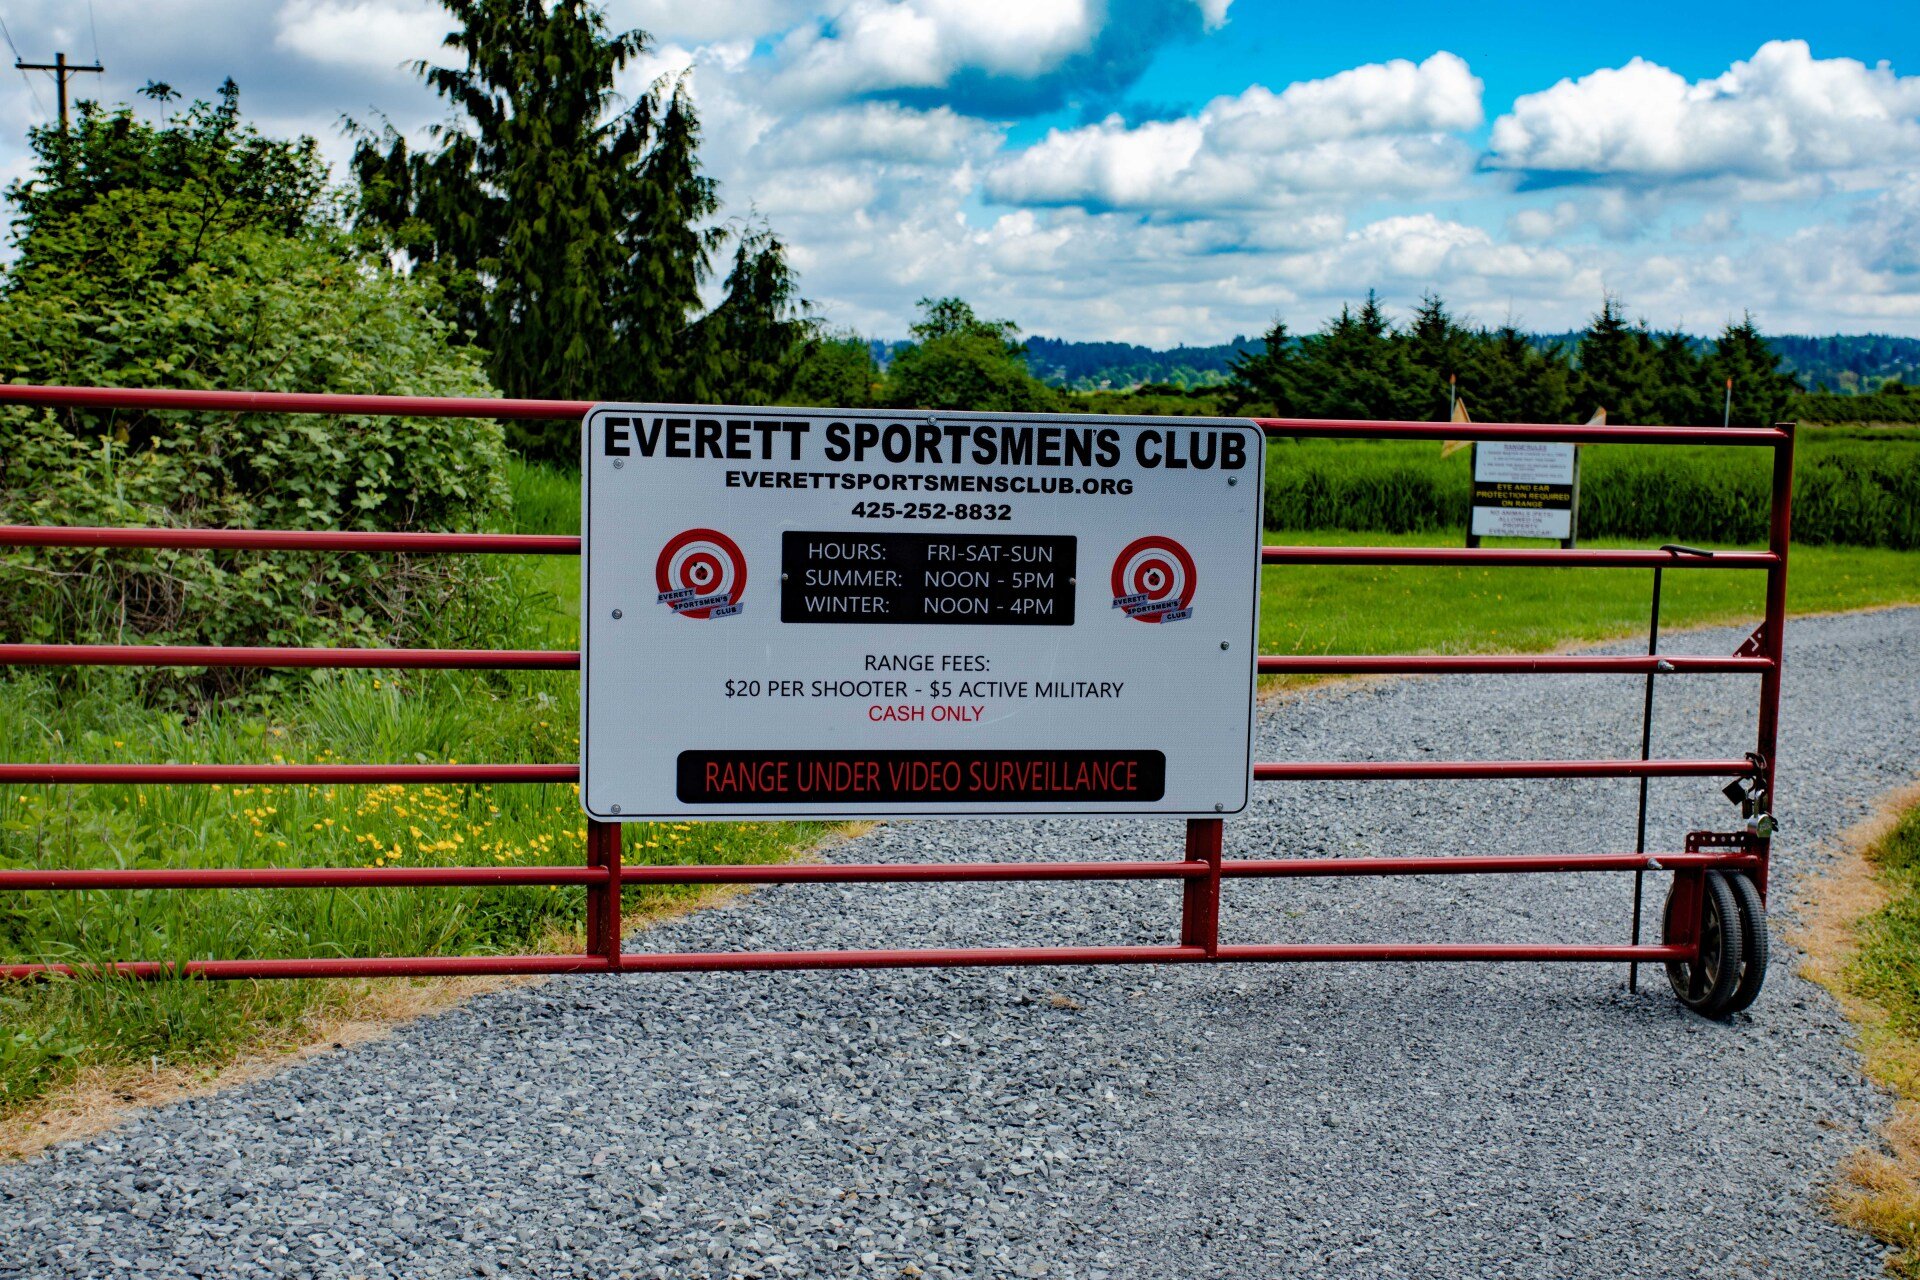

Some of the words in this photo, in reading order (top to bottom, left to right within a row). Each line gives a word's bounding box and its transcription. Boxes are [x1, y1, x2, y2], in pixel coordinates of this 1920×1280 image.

[604, 417, 810, 460] EVERETT
[824, 422, 1120, 468] SPORTSMEN'S
[1135, 429, 1247, 470] CLUB
[725, 470, 1133, 495] EVERETTSPORTSMENSCLUB.ORG
[1476, 491, 1526, 499] PROTECTION
[1529, 493, 1570, 501] REQUIRED
[851, 502, 1012, 521] 425-252-8832
[808, 542, 886, 560] HOURS:
[927, 544, 1053, 562] FRI-SAT-SUN
[805, 569, 902, 587] SUMMER:
[925, 571, 990, 588] NOON
[1012, 572, 1054, 588] 5PM
[658, 589, 694, 601] EVERETT
[673, 595, 728, 610] SPORTSMEN'S
[1113, 595, 1147, 606] EVERETT
[716, 606, 737, 615] CLUB
[805, 596, 889, 613] WINTER:
[924, 597, 989, 614] NOON
[1010, 598, 1053, 615] 4PM
[1127, 601, 1178, 615] SPORTSMEN'S
[1166, 611, 1186, 620] CLUB
[865, 655, 934, 671] RANGE
[942, 655, 990, 672] FEES:
[725, 679, 761, 698] $20
[768, 681, 805, 697] PER
[811, 681, 908, 697] SHOOTER
[930, 680, 952, 699] $5
[958, 681, 1028, 698] ACTIVE
[1035, 682, 1124, 698] MILITARY
[869, 705, 925, 722] CASH
[931, 705, 985, 722] ONLY
[706, 761, 789, 792] RANGE
[797, 761, 880, 792] UNDER
[889, 760, 961, 792] VIDEO
[969, 760, 1138, 792] SURVEILLANCE
